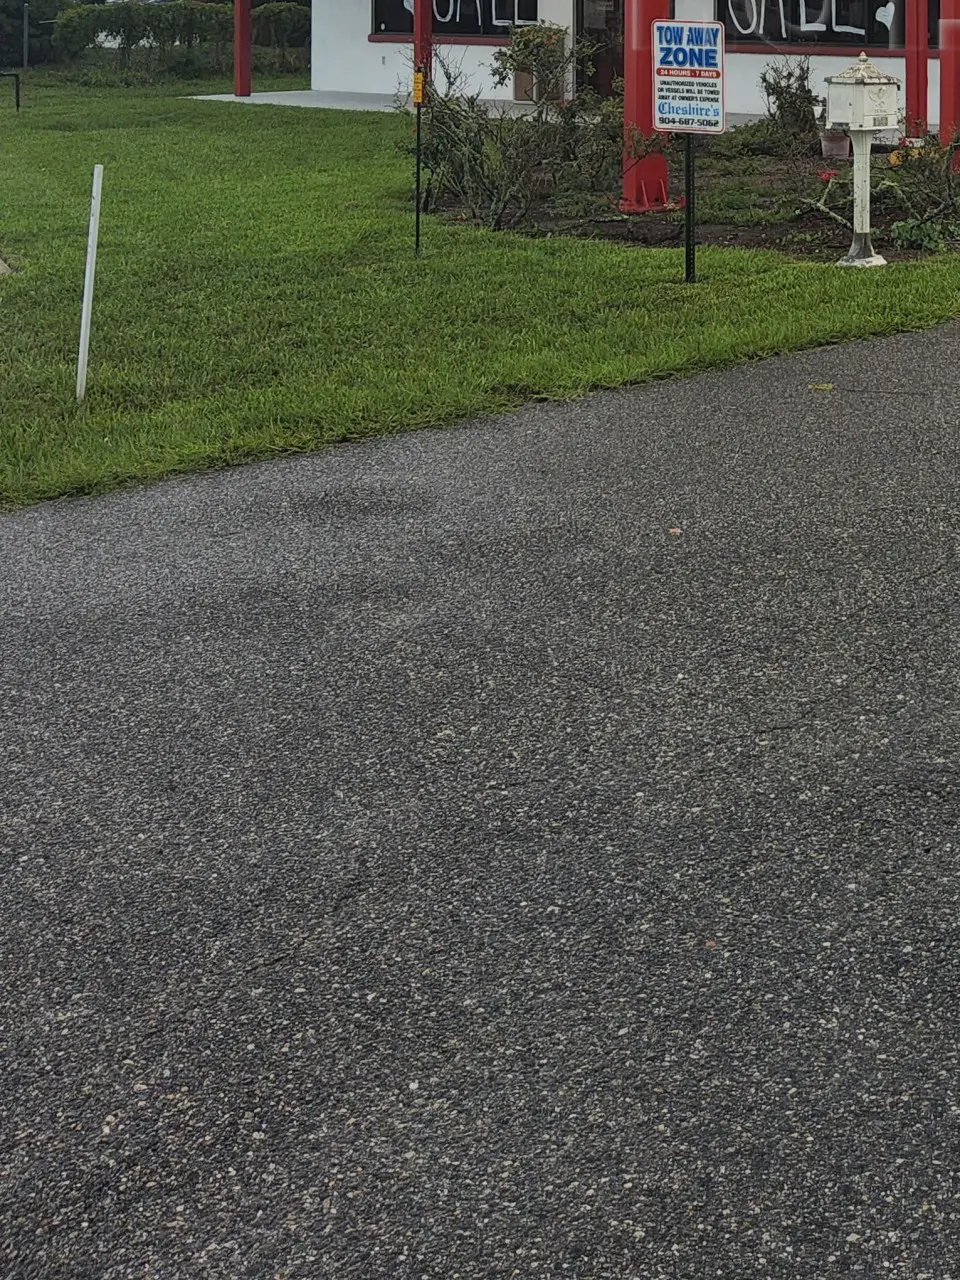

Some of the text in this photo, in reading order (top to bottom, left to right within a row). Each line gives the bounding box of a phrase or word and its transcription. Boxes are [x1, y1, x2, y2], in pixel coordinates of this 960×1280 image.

[656, 25, 720, 47] TOW AWAY
[659, 47, 718, 68] ZONE
[658, 101, 719, 117] Cheshire's
